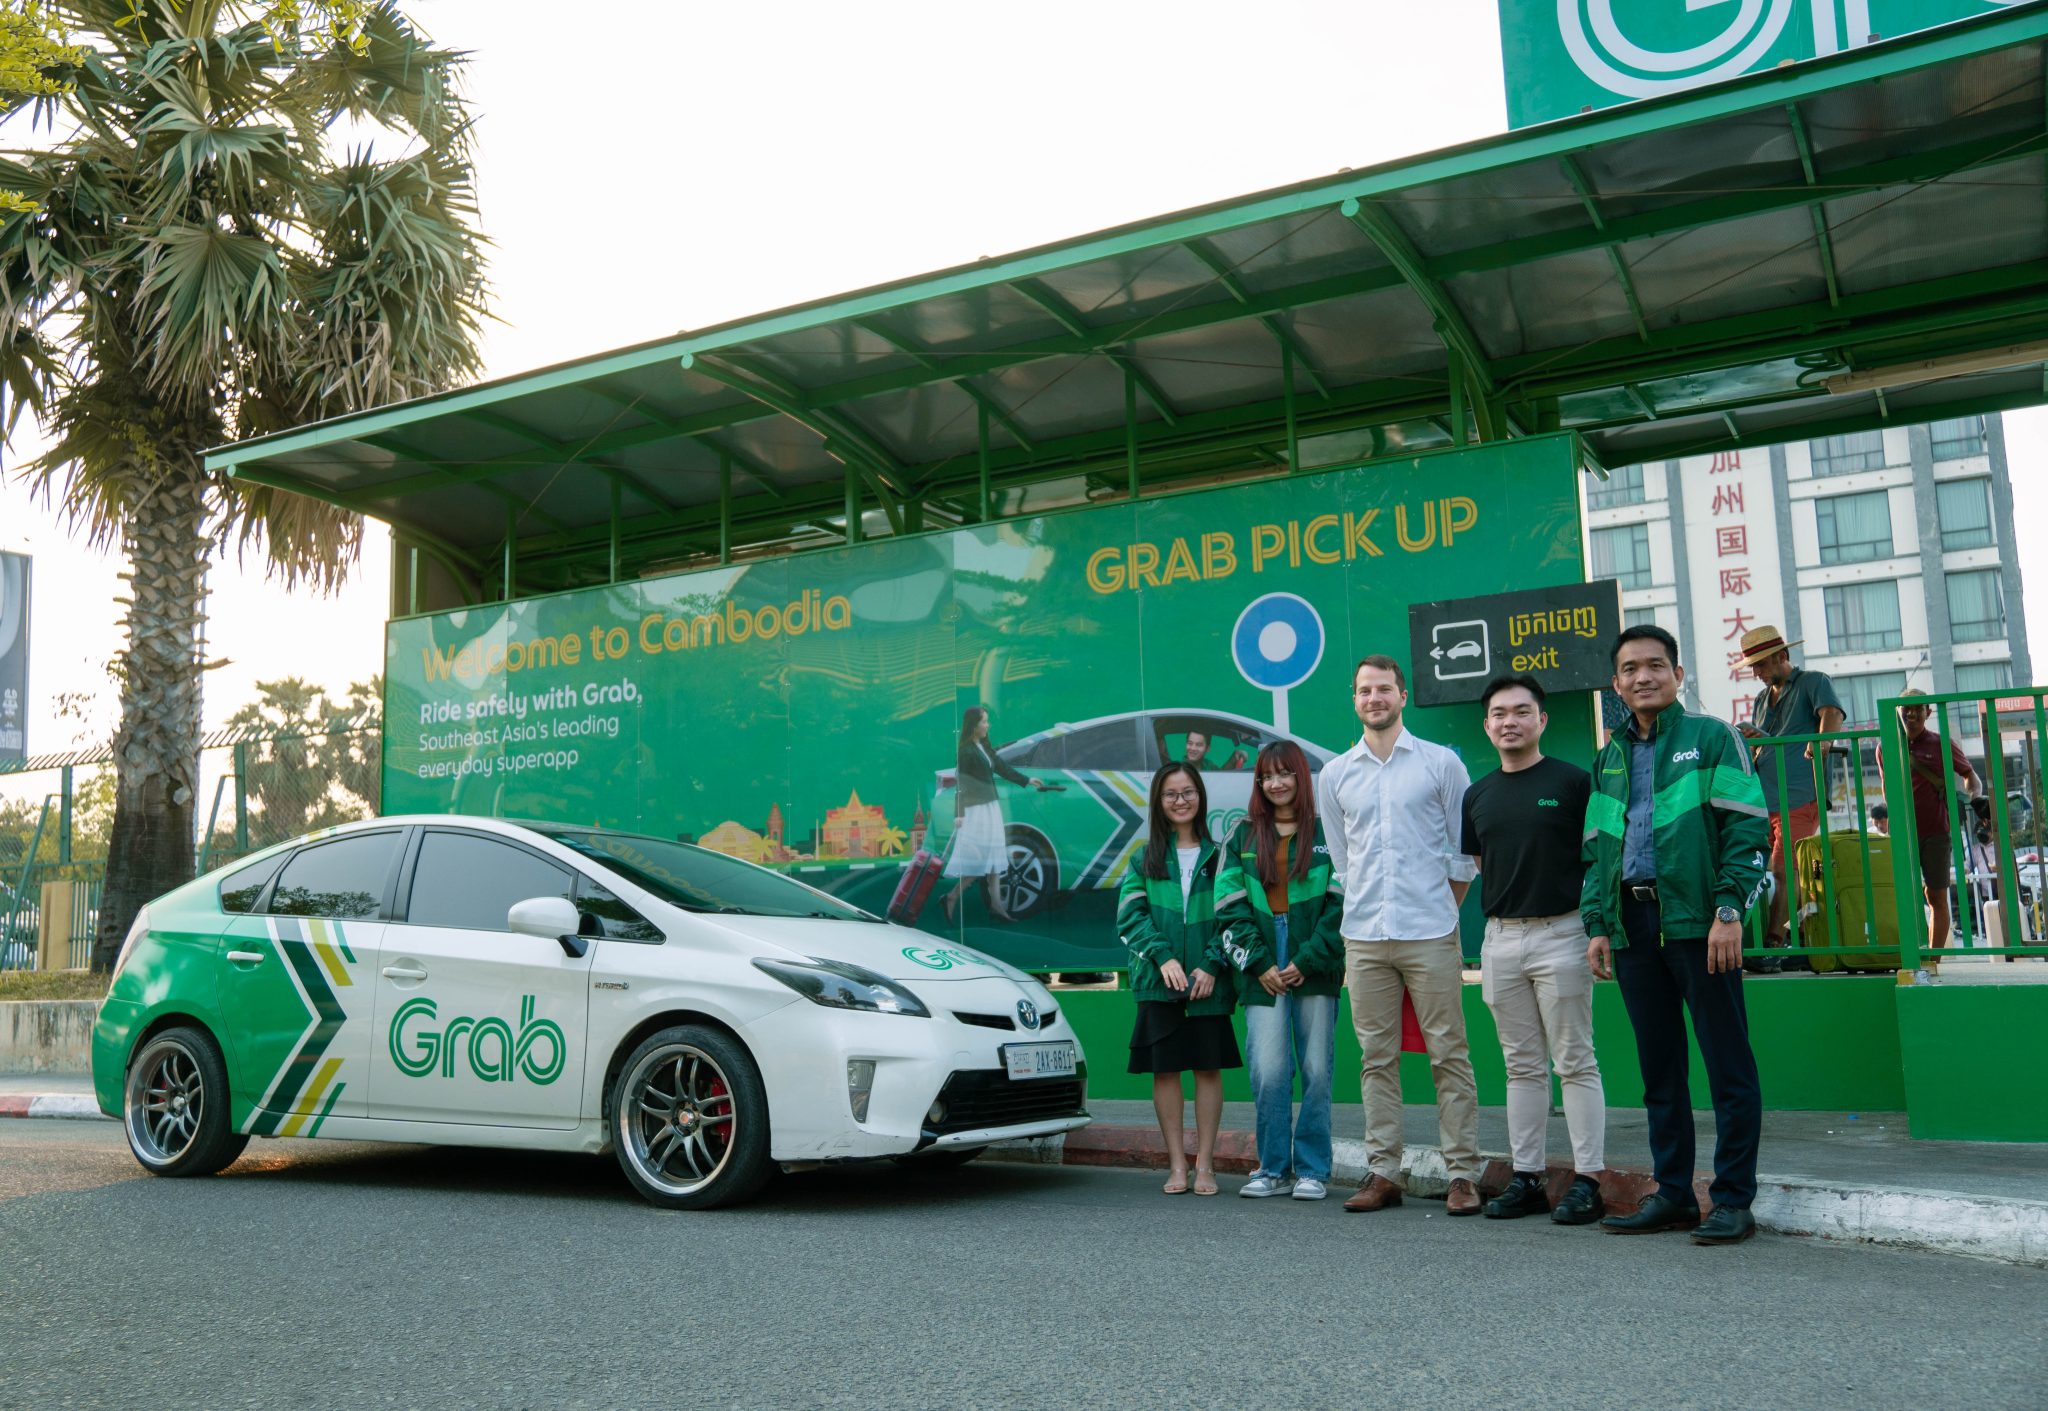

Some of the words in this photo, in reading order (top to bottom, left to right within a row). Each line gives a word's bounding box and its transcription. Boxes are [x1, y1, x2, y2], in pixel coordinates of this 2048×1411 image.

[1086, 531, 1237, 594] GRAB
[1251, 508, 1385, 573] PICK
[1395, 496, 1478, 552] UP
[422, 632, 581, 683] Welcome
[589, 624, 629, 660] to
[639, 588, 851, 654] Cambodia
[1508, 606, 1597, 646] ច្រកចេញ
[1512, 646, 1560, 672] exit
[420, 699, 461, 725] Ride
[466, 692, 528, 719] safely
[533, 684, 577, 711] with
[582, 677, 643, 705] Grab,
[419, 727, 498, 752] Southeast
[502, 721, 548, 743] Asia's
[553, 714, 619, 738] leading
[418, 754, 493, 780] everyday
[497, 749, 579, 774] superapp
[1673, 747, 1700, 763] Grab
[1537, 798, 1559, 807] Grab
[1312, 844, 1330, 855] rab
[389, 995, 566, 1085] Grab
